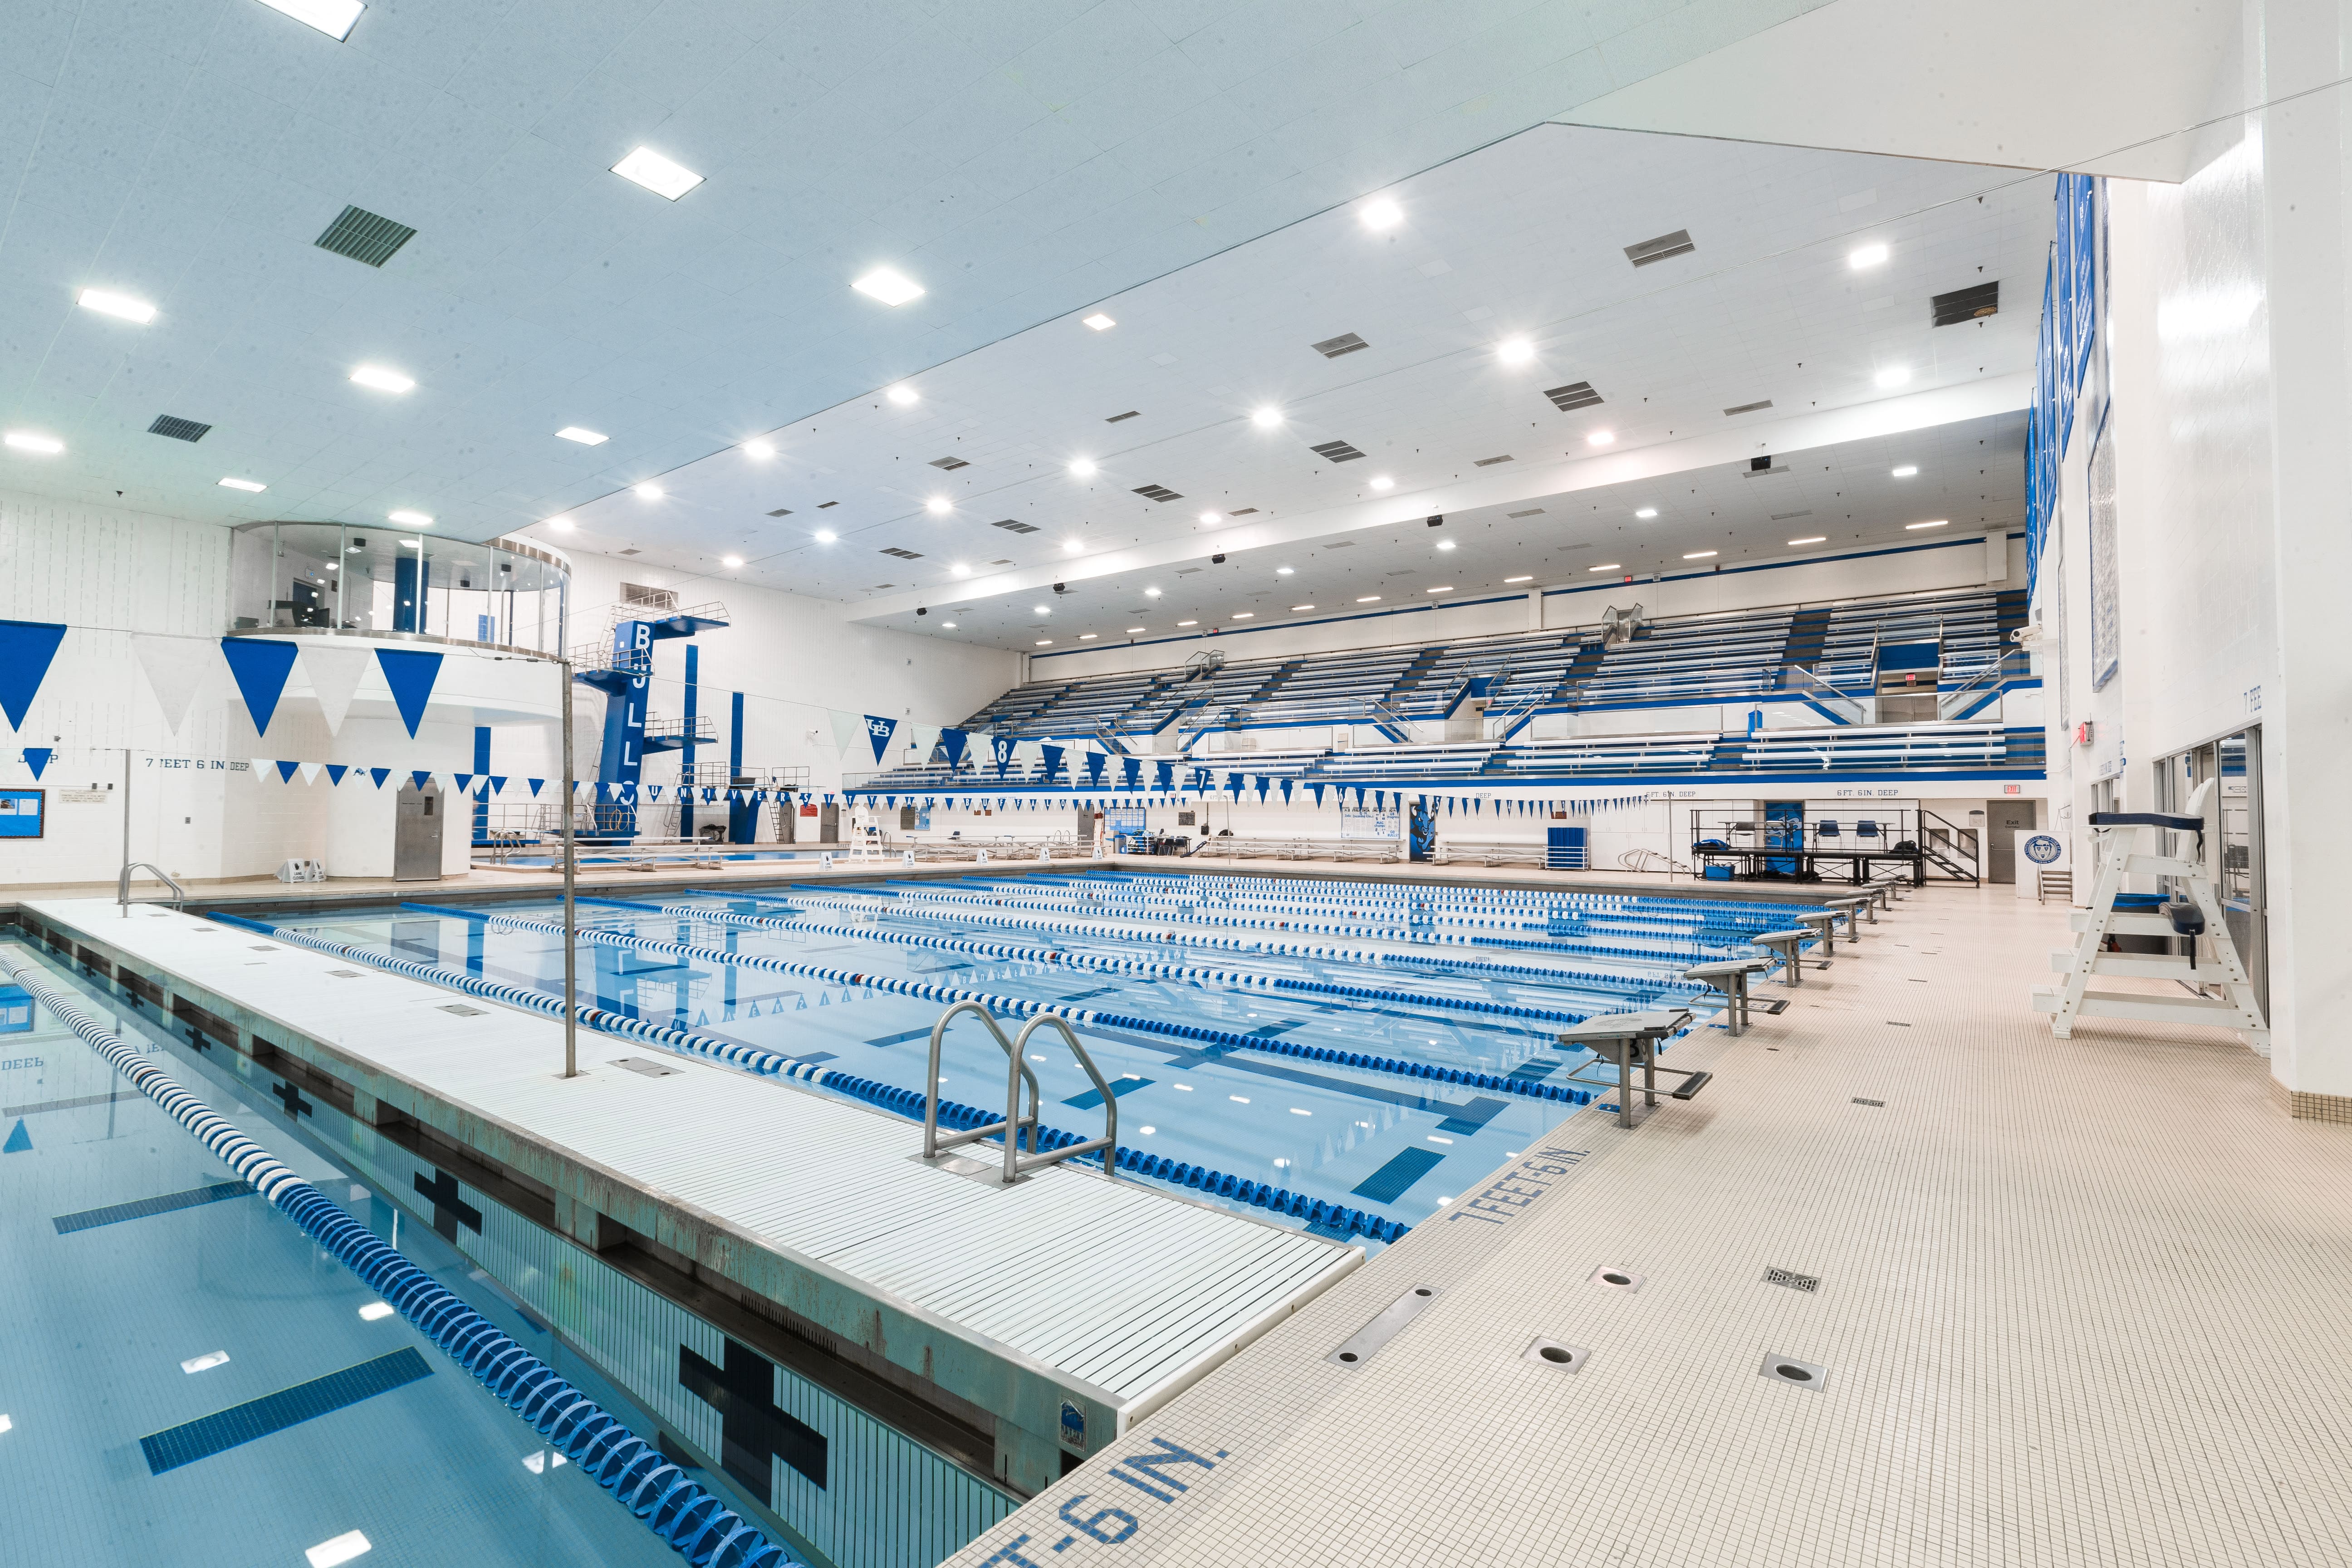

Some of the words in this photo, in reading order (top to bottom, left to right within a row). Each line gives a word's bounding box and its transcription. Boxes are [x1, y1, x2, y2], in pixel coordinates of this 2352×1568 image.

[866, 719, 889, 737] UB
[18, 754, 58, 764] DP
[998, 740, 1008, 763] 8
[146, 759, 153, 767] 7
[197, 760, 204, 769] 6
[230, 762, 250, 771] DEEP
[1199, 770, 1206, 789] 7
[1338, 788, 1344, 803] 6
[1435, 797, 1441, 810] 5
